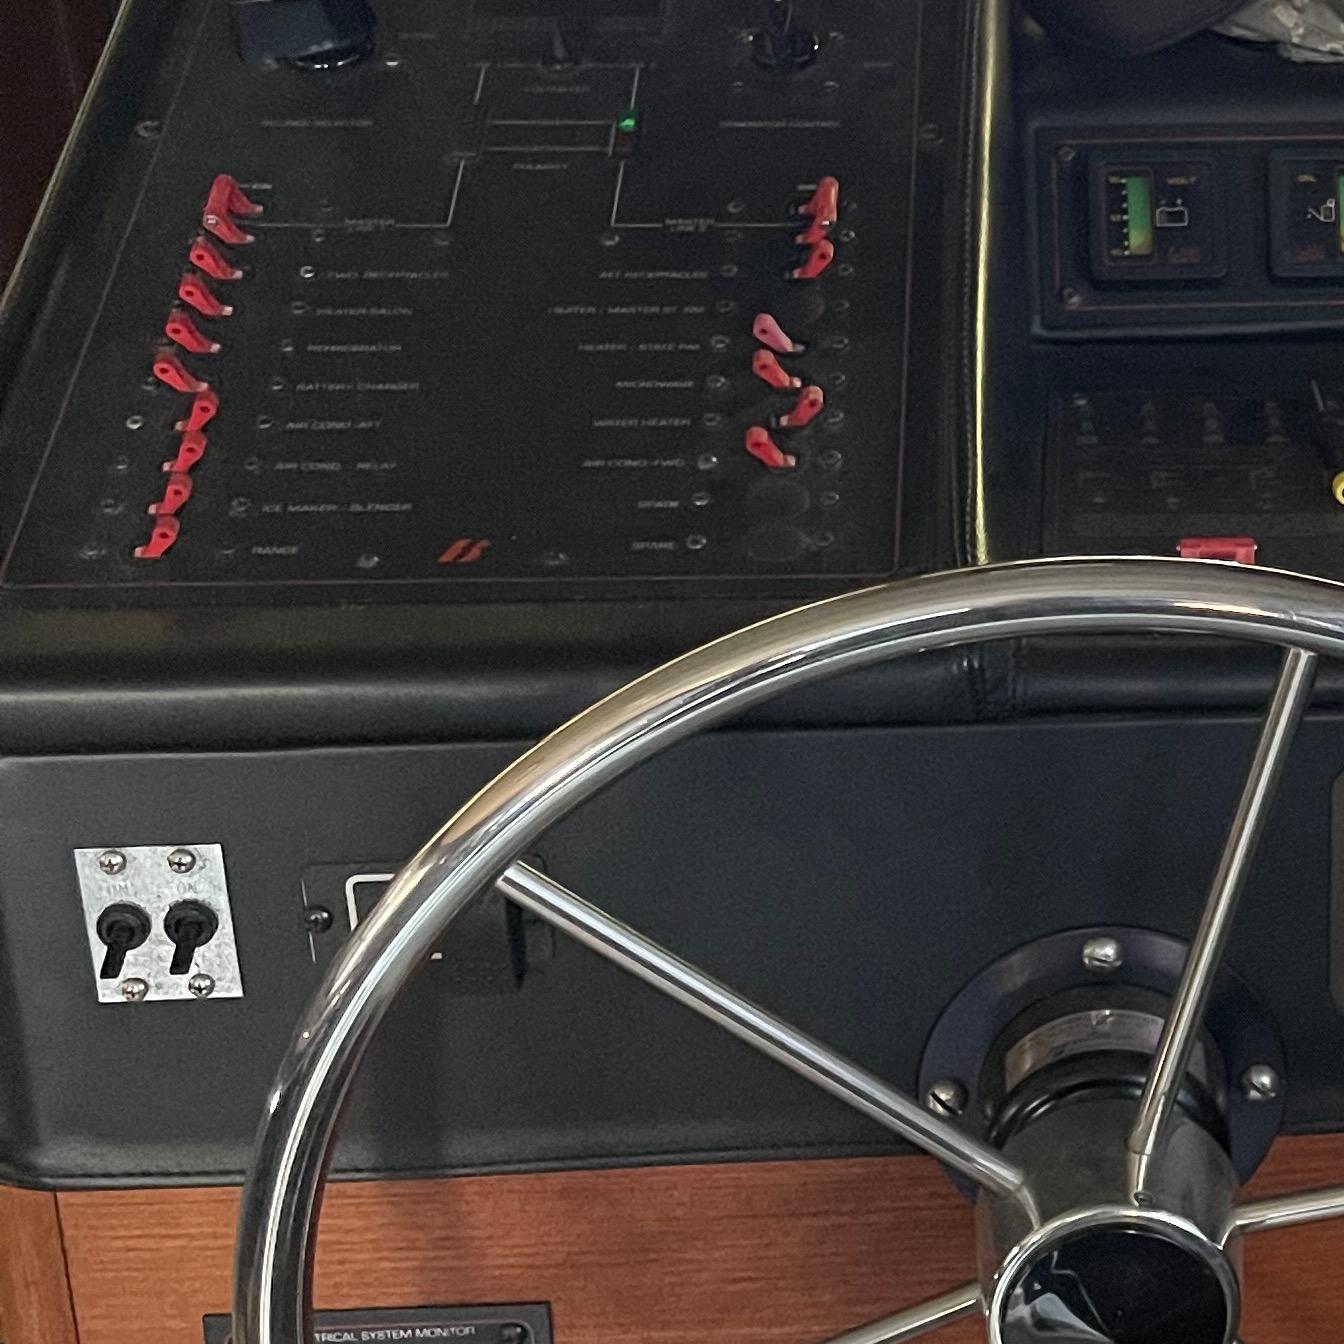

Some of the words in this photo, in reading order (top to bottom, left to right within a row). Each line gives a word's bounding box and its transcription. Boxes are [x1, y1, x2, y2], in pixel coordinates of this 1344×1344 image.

[314, 1332, 359, 1343] TRICAL
[361, 1329, 412, 1342] SYSTEM
[413, 1326, 475, 1339] MONITOR
